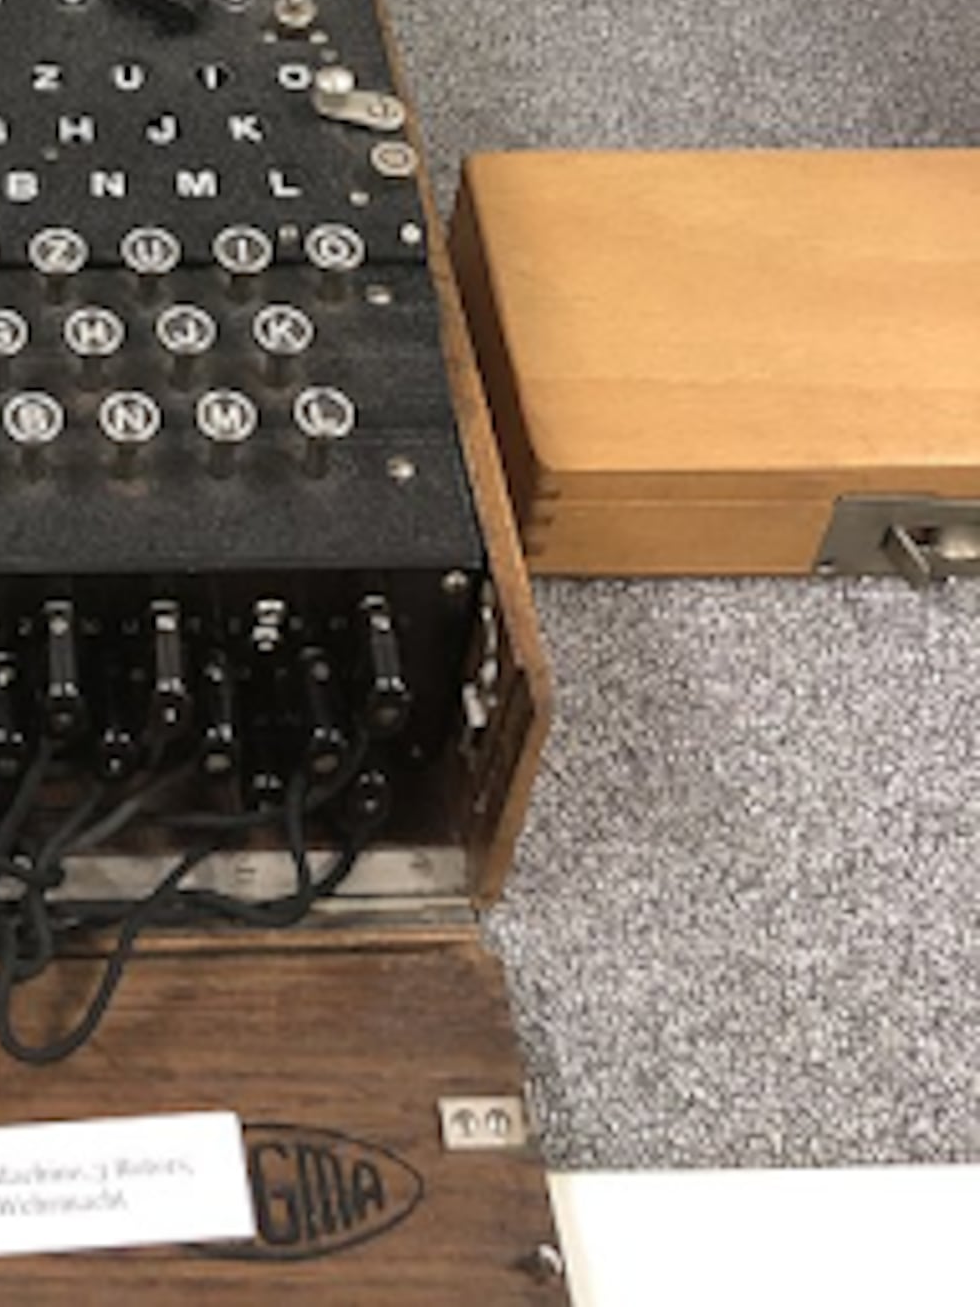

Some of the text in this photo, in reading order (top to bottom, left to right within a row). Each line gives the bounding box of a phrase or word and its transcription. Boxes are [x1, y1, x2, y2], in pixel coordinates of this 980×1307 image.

[32, 64, 61, 90] Z
[113, 64, 145, 90] U
[59, 115, 94, 143] H
[147, 115, 177, 144] J
[229, 115, 263, 142] K
[6, 172, 39, 201] B
[91, 170, 125, 198] N
[176, 170, 217, 197] M
[269, 170, 301, 198] L
